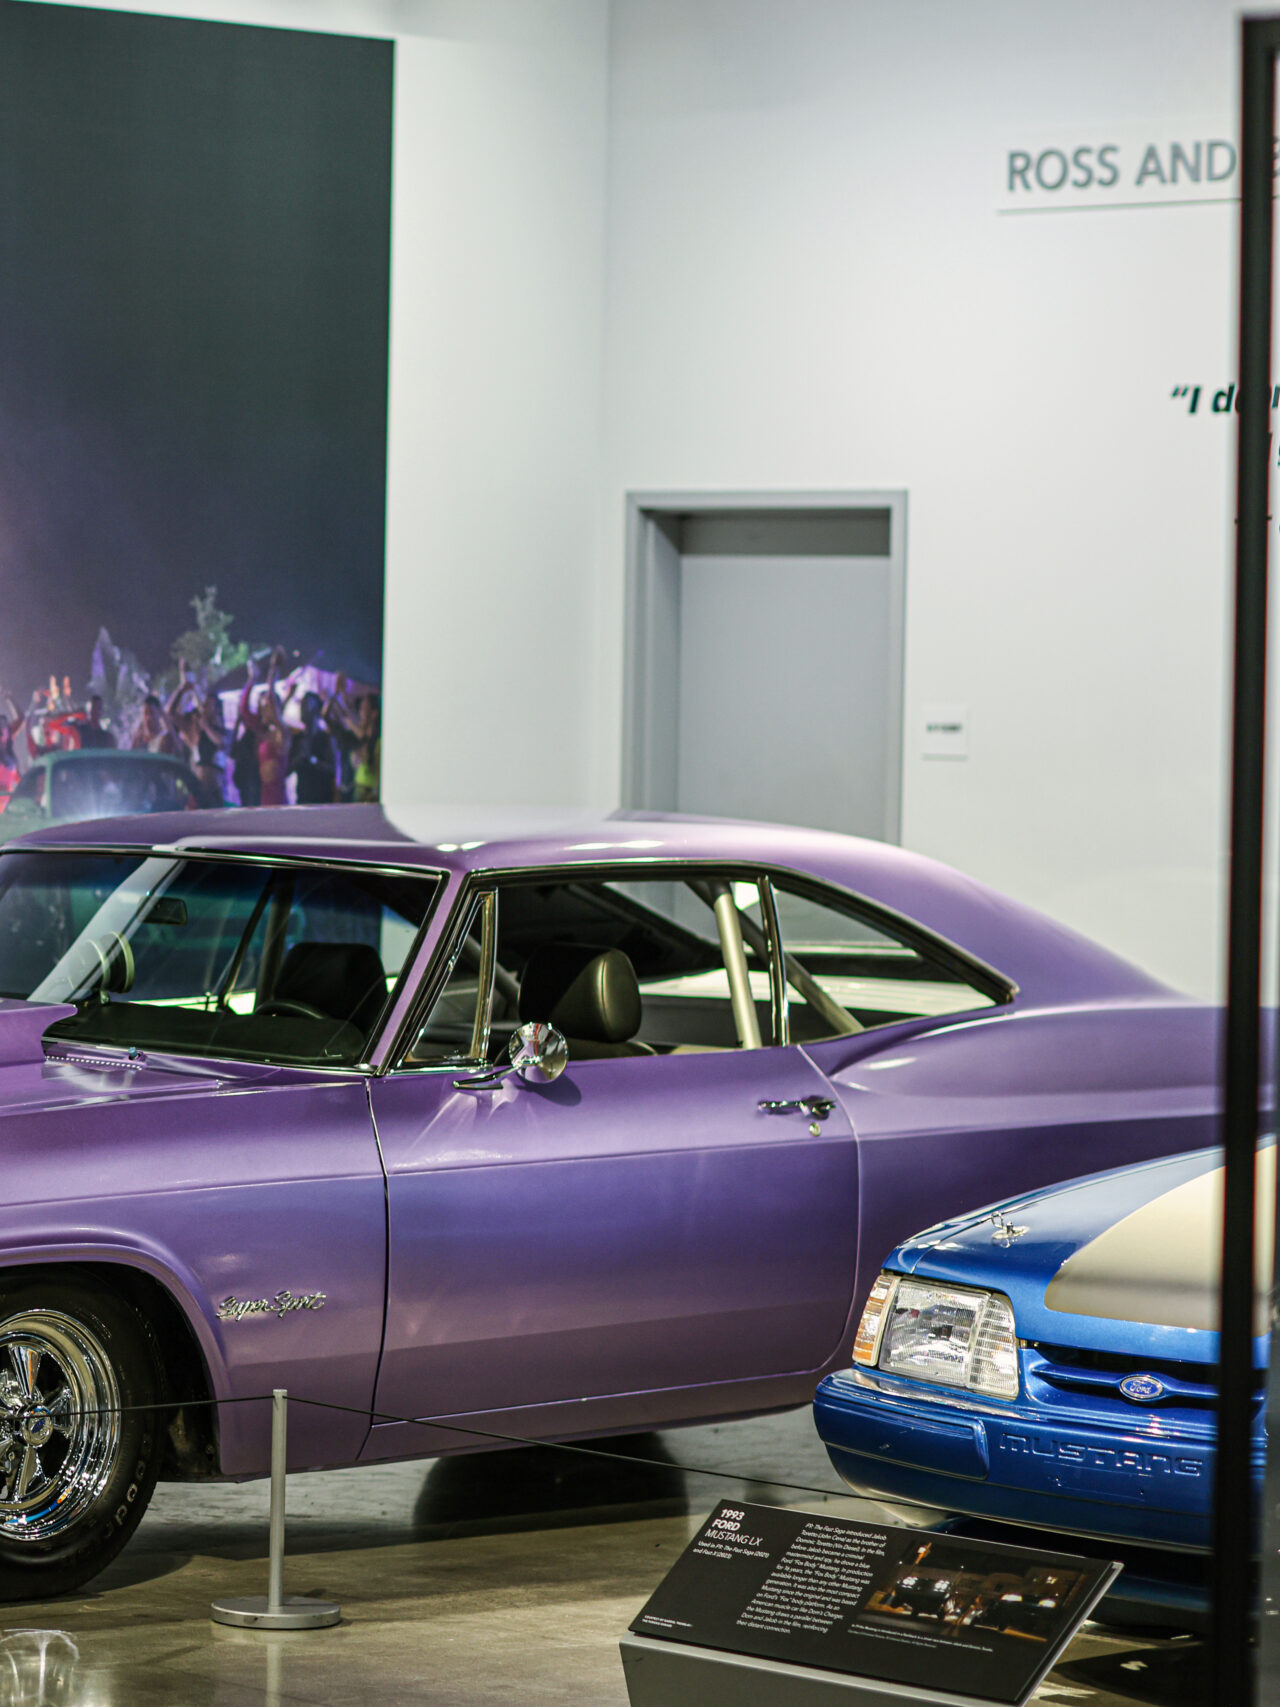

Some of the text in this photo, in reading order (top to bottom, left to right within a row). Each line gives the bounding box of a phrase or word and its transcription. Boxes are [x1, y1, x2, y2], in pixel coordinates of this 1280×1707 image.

[1007, 145, 1121, 192] ROSS
[1134, 139, 1238, 187] AND
[215, 1290, 328, 1323] Super Sport
[1127, 1378, 1154, 1396] Ford
[999, 1432, 1205, 1478] MUSTANG
[721, 1509, 745, 1520] 1993
[712, 1519, 740, 1531] FORD
[705, 1529, 763, 1546] MUSTANG LX
